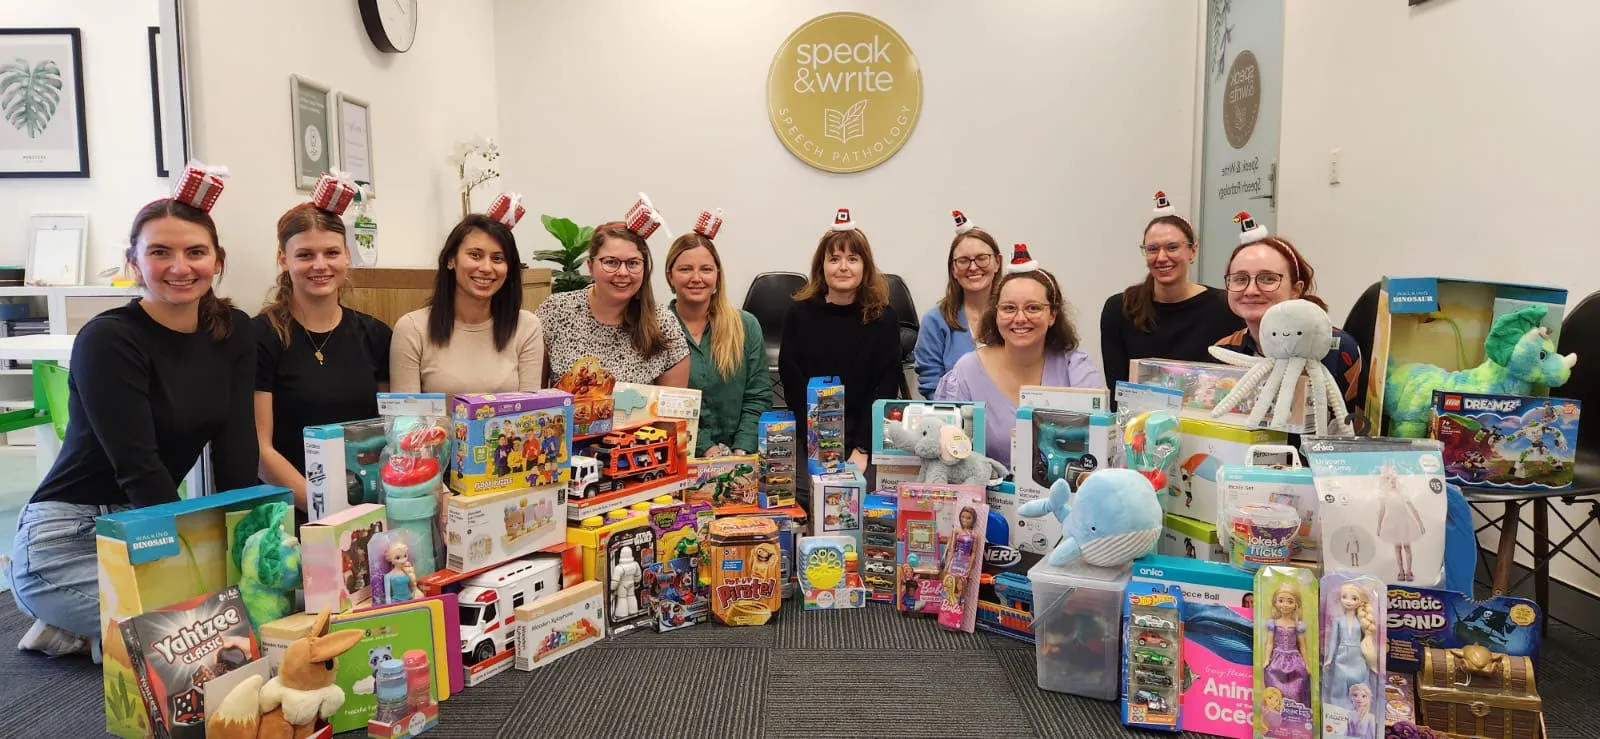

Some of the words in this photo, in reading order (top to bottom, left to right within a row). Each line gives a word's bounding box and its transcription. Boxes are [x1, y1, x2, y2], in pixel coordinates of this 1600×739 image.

[796, 34, 892, 70] speak
[779, 107, 823, 158] SPEECH
[832, 105, 912, 161] PATHOLOGY
[1393, 296, 1433, 304] DINOSAUR
[132, 536, 175, 551] DINOSAUR
[134, 531, 169, 541] WALKING
[1140, 567, 1164, 577] anko
[1182, 590, 1202, 598] occe
[1204, 592, 1220, 600] Ball
[940, 599, 963, 615] Barbie
[152, 605, 241, 664] Yahtzee
[182, 637, 224, 665] CLASSIC
